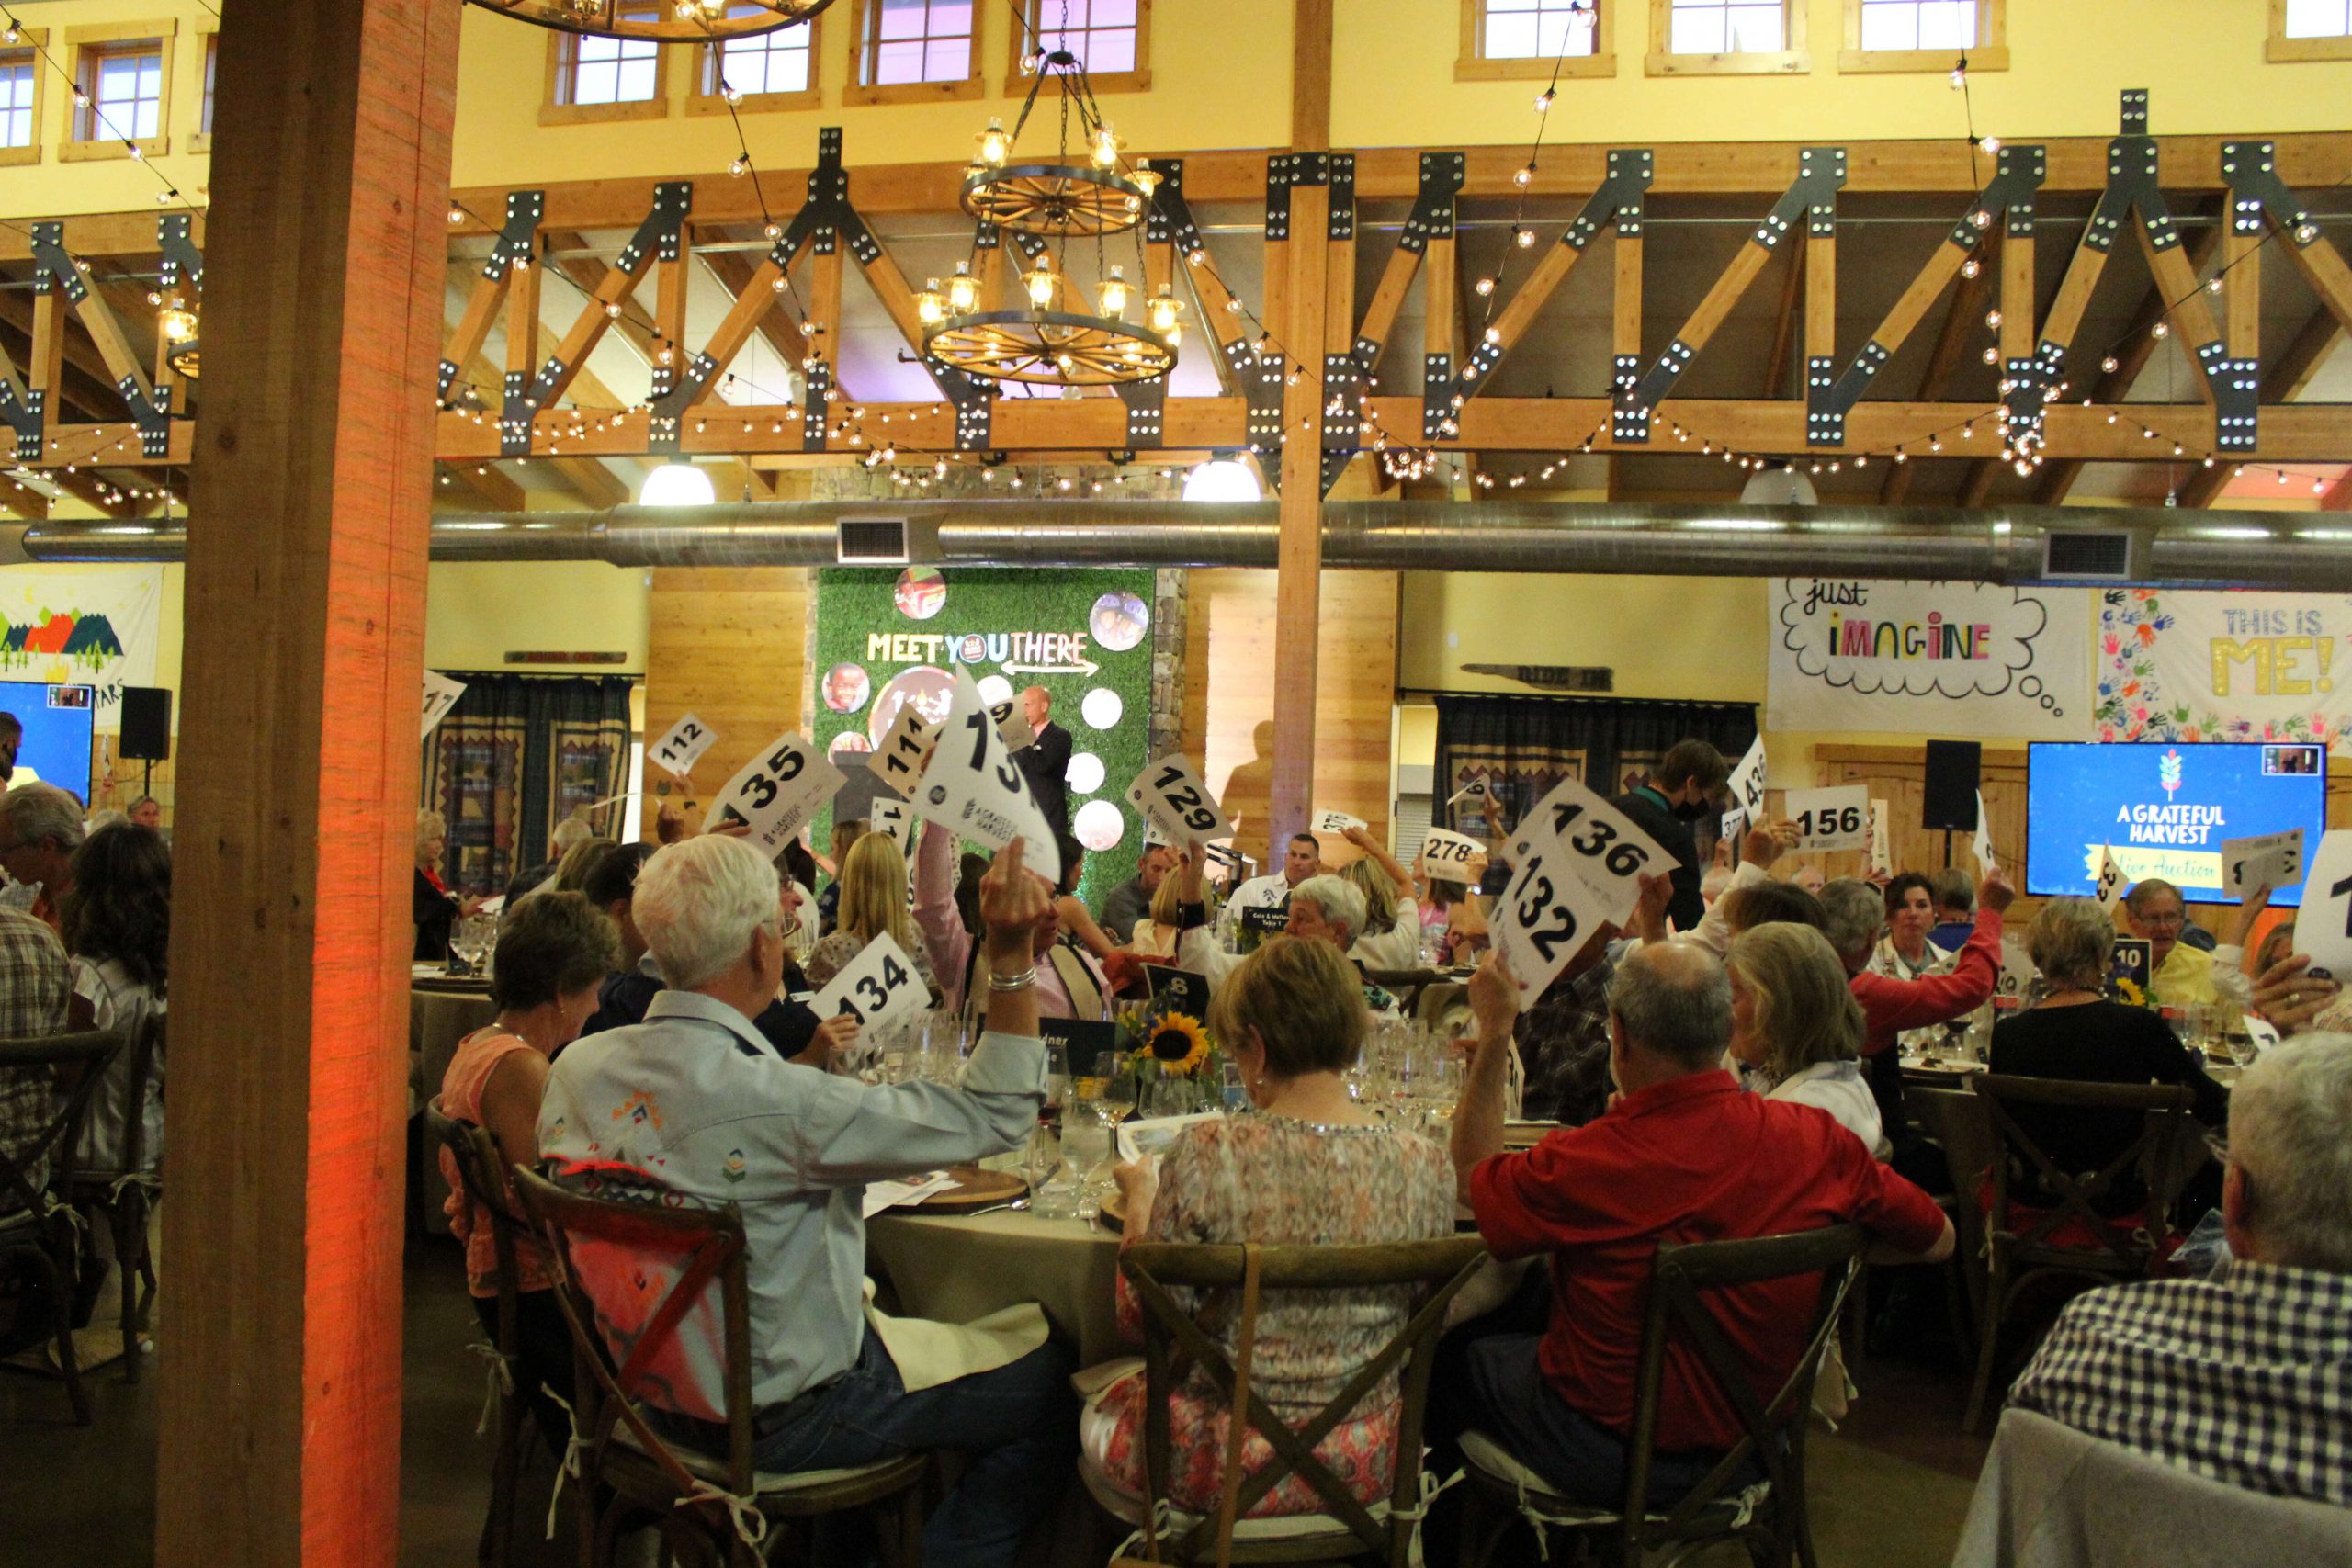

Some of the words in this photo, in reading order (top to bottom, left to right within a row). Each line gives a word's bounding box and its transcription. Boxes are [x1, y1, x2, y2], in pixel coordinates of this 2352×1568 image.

[1804, 579, 1869, 615] just
[2222, 608, 2288, 636] THIS
[2296, 609, 2323, 636] IS
[866, 632, 944, 663] MEET
[1010, 631, 1089, 665] THERE
[2209, 636, 2335, 696] ME!
[661, 723, 703, 761] 112
[1154, 765, 1217, 831] 129
[1797, 807, 1860, 836] 156
[2116, 805, 2131, 823] A
[2132, 805, 2226, 826] GRATEFUL
[1426, 837, 1473, 863] 278
[1552, 802, 1650, 877] 136
[2129, 824, 2211, 845] HARVEST
[2153, 855, 2216, 878] Auction
[1514, 855, 1577, 964] 132
[2117, 948, 2142, 967] 10
[838, 953, 909, 1026] 134
